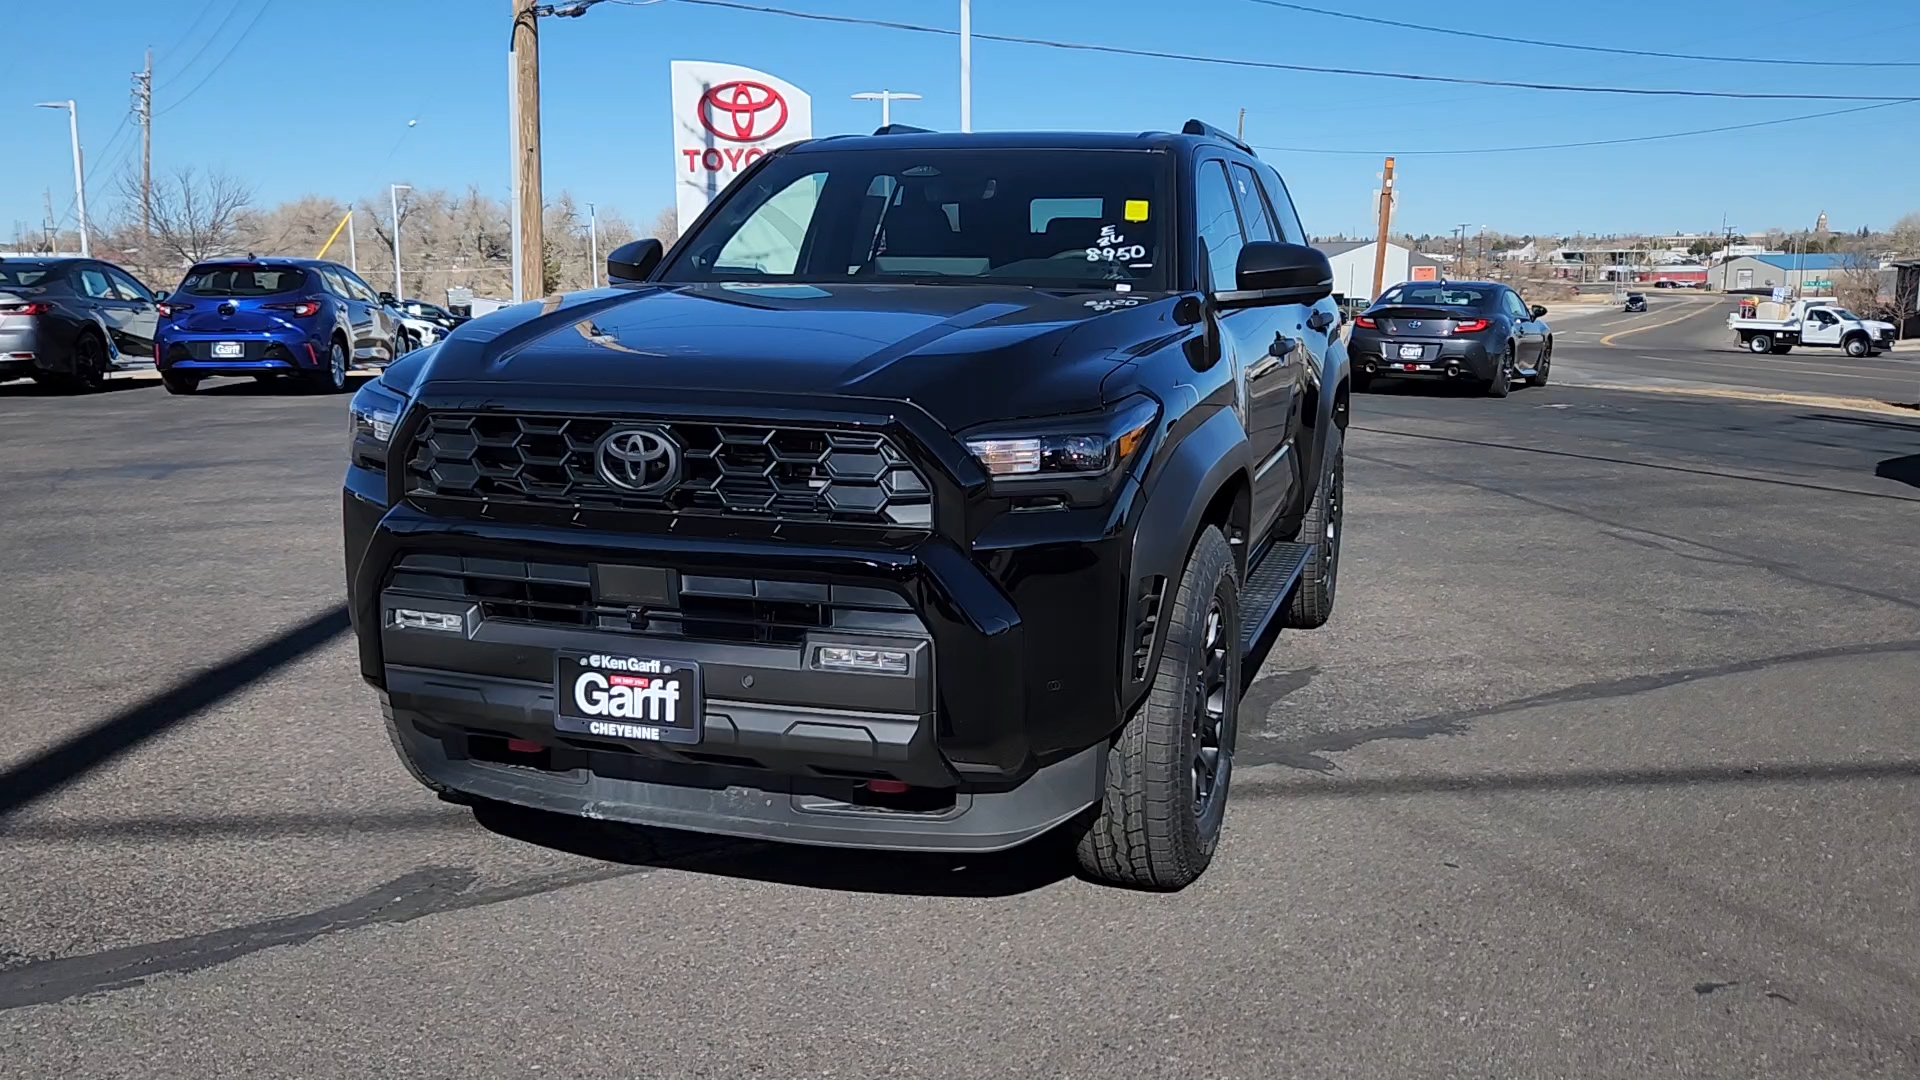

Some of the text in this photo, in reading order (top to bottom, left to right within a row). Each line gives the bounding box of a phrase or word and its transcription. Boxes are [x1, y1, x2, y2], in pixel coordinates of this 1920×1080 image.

[1085, 244, 1146, 262] 8950
[601, 655, 661, 674] Ken Garff
[574, 671, 680, 722] Garff
[590, 721, 660, 740] CHEYENNE
